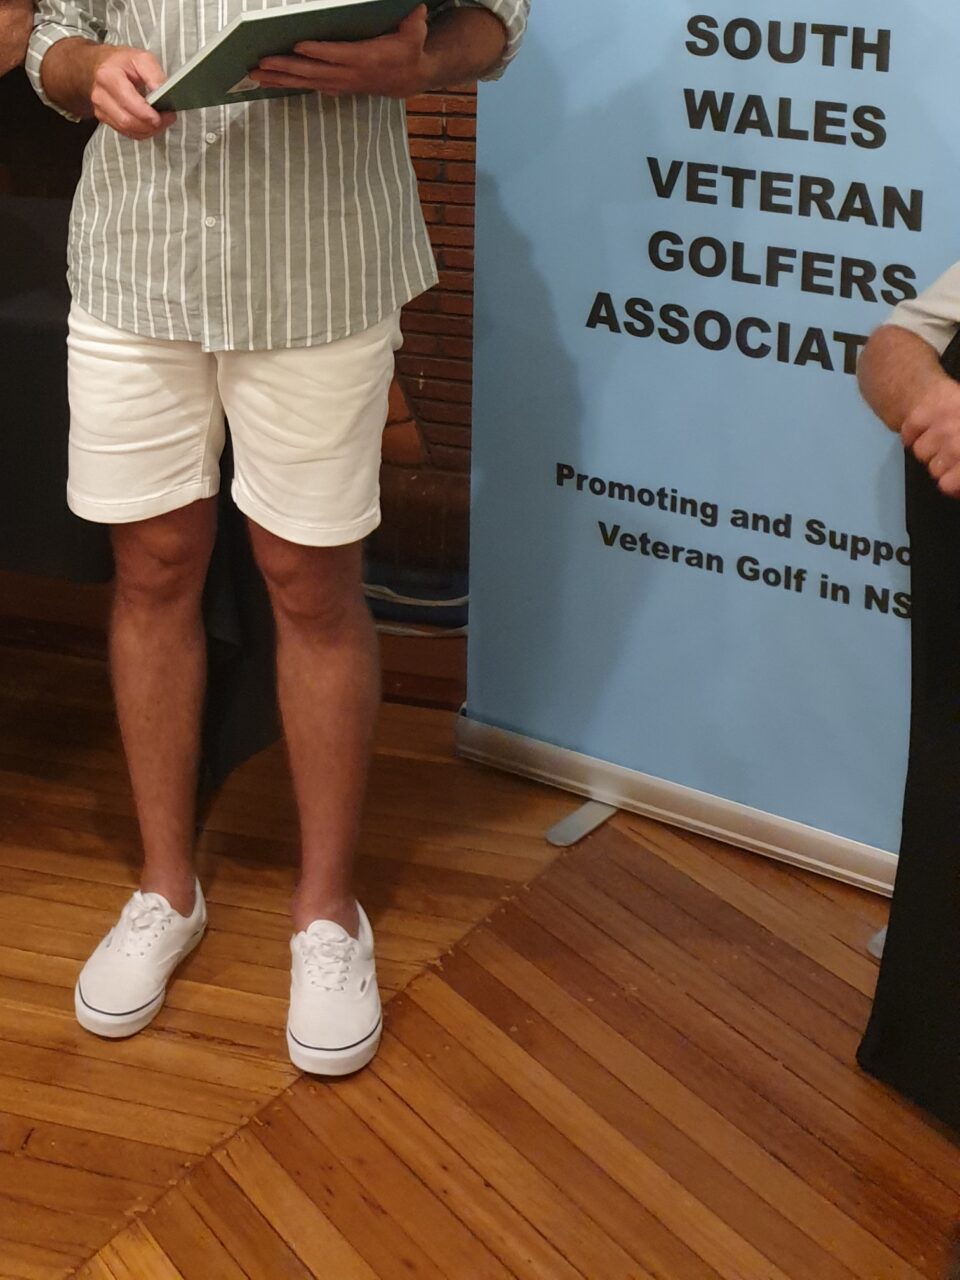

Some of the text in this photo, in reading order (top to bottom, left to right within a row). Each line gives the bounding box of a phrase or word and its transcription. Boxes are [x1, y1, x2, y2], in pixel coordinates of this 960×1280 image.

[685, 14, 891, 73] SOUTH
[683, 88, 887, 150] WALES
[645, 156, 924, 233] VETERAN
[647, 229, 918, 307] GOLFERS
[584, 291, 870, 376] ASSOCIAT
[555, 462, 911, 567] Promoting and Suppo
[596, 520, 912, 619] Veteran Golf in NS
